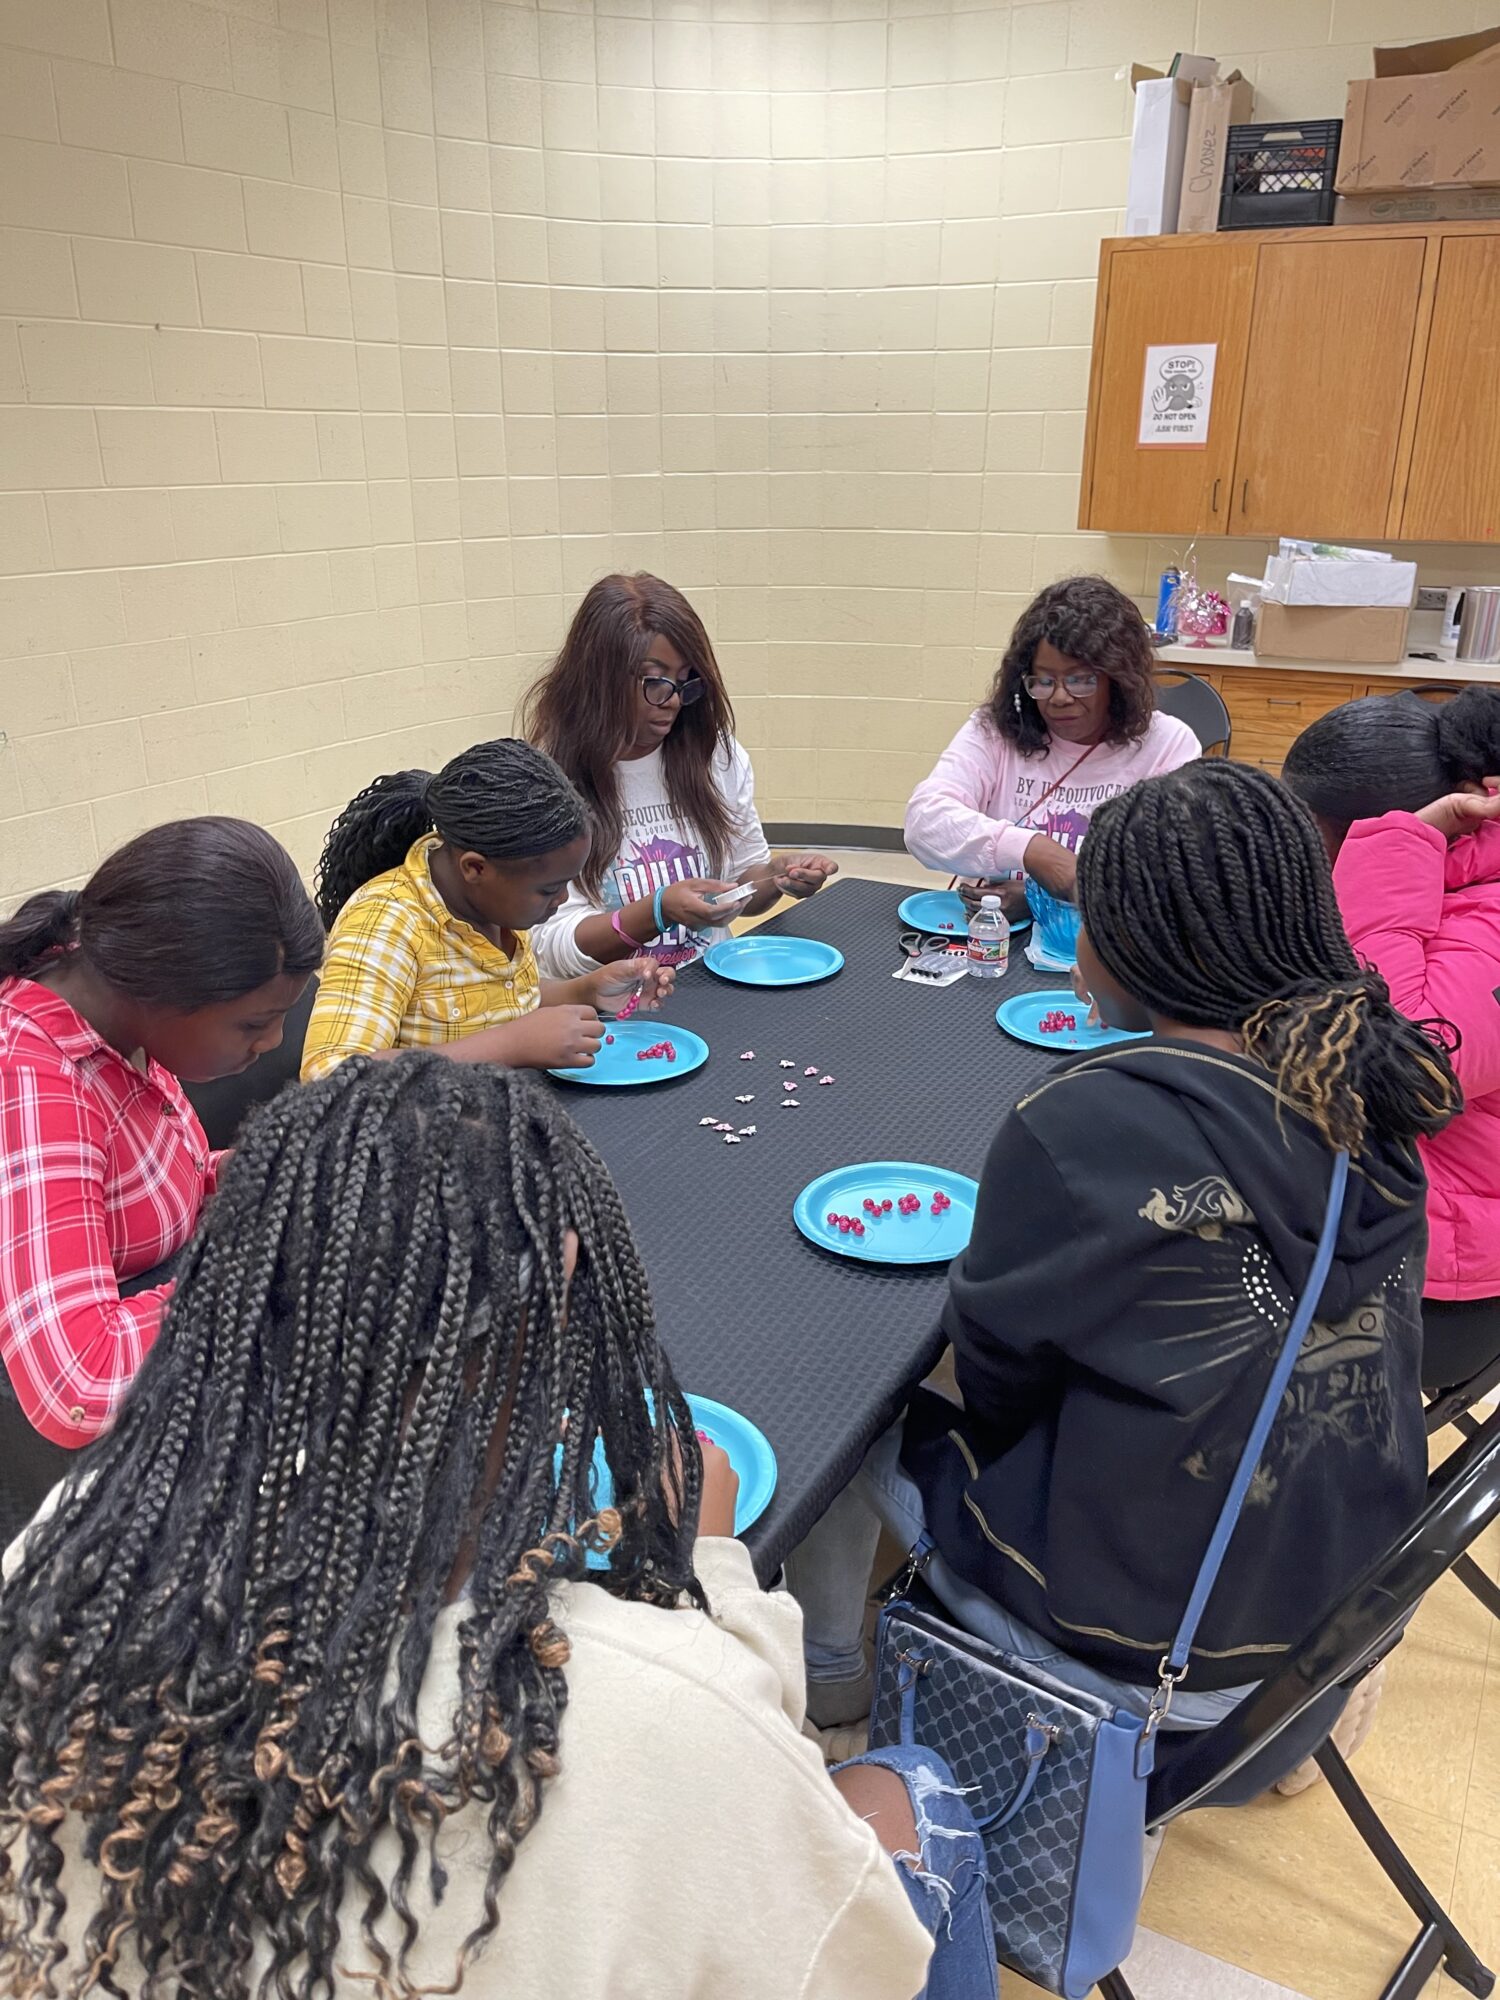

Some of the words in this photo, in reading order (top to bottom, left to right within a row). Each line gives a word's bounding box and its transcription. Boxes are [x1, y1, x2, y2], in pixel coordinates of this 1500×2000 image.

[1189, 124, 1217, 193] Chavez
[1168, 360, 1195, 369] STOP!
[1153, 413, 1162, 421] DO
[1178, 412, 1197, 420] OPEN
[1172, 424, 1194, 432] FIRST
[1016, 776, 1035, 796] BY
[645, 823, 674, 836] LOVING
